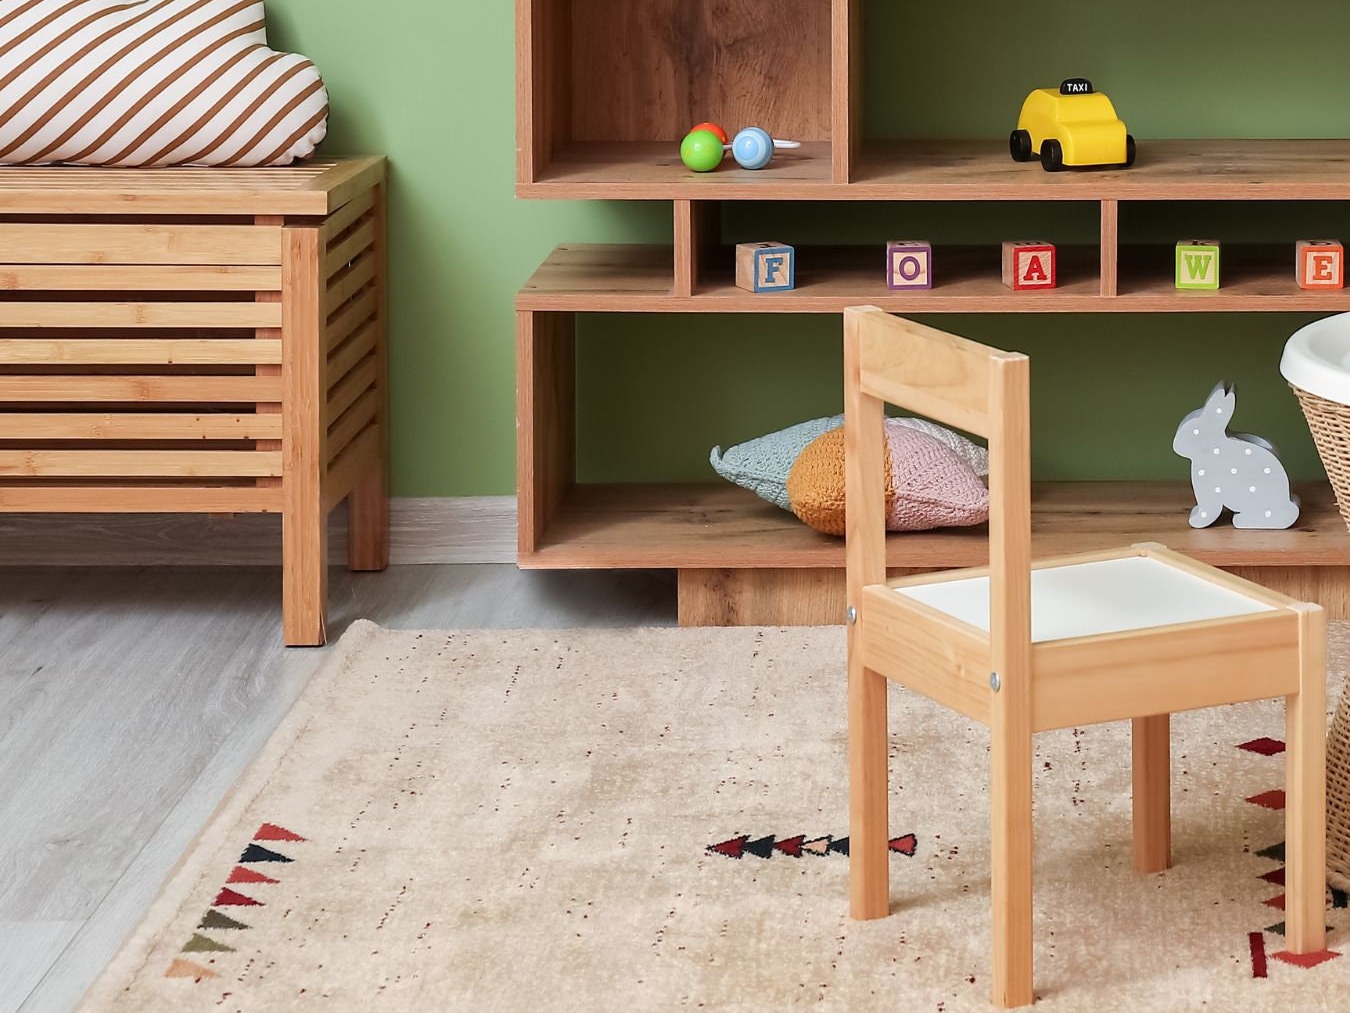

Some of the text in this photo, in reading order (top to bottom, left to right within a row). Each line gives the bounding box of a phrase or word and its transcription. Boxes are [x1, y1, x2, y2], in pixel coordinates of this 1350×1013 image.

[1066, 83, 1088, 92] TAXI
[764, 257, 784, 284] F
[899, 255, 921, 281] O
[1023, 254, 1047, 281] A
[1184, 254, 1212, 280] W
[1312, 255, 1333, 281] E
